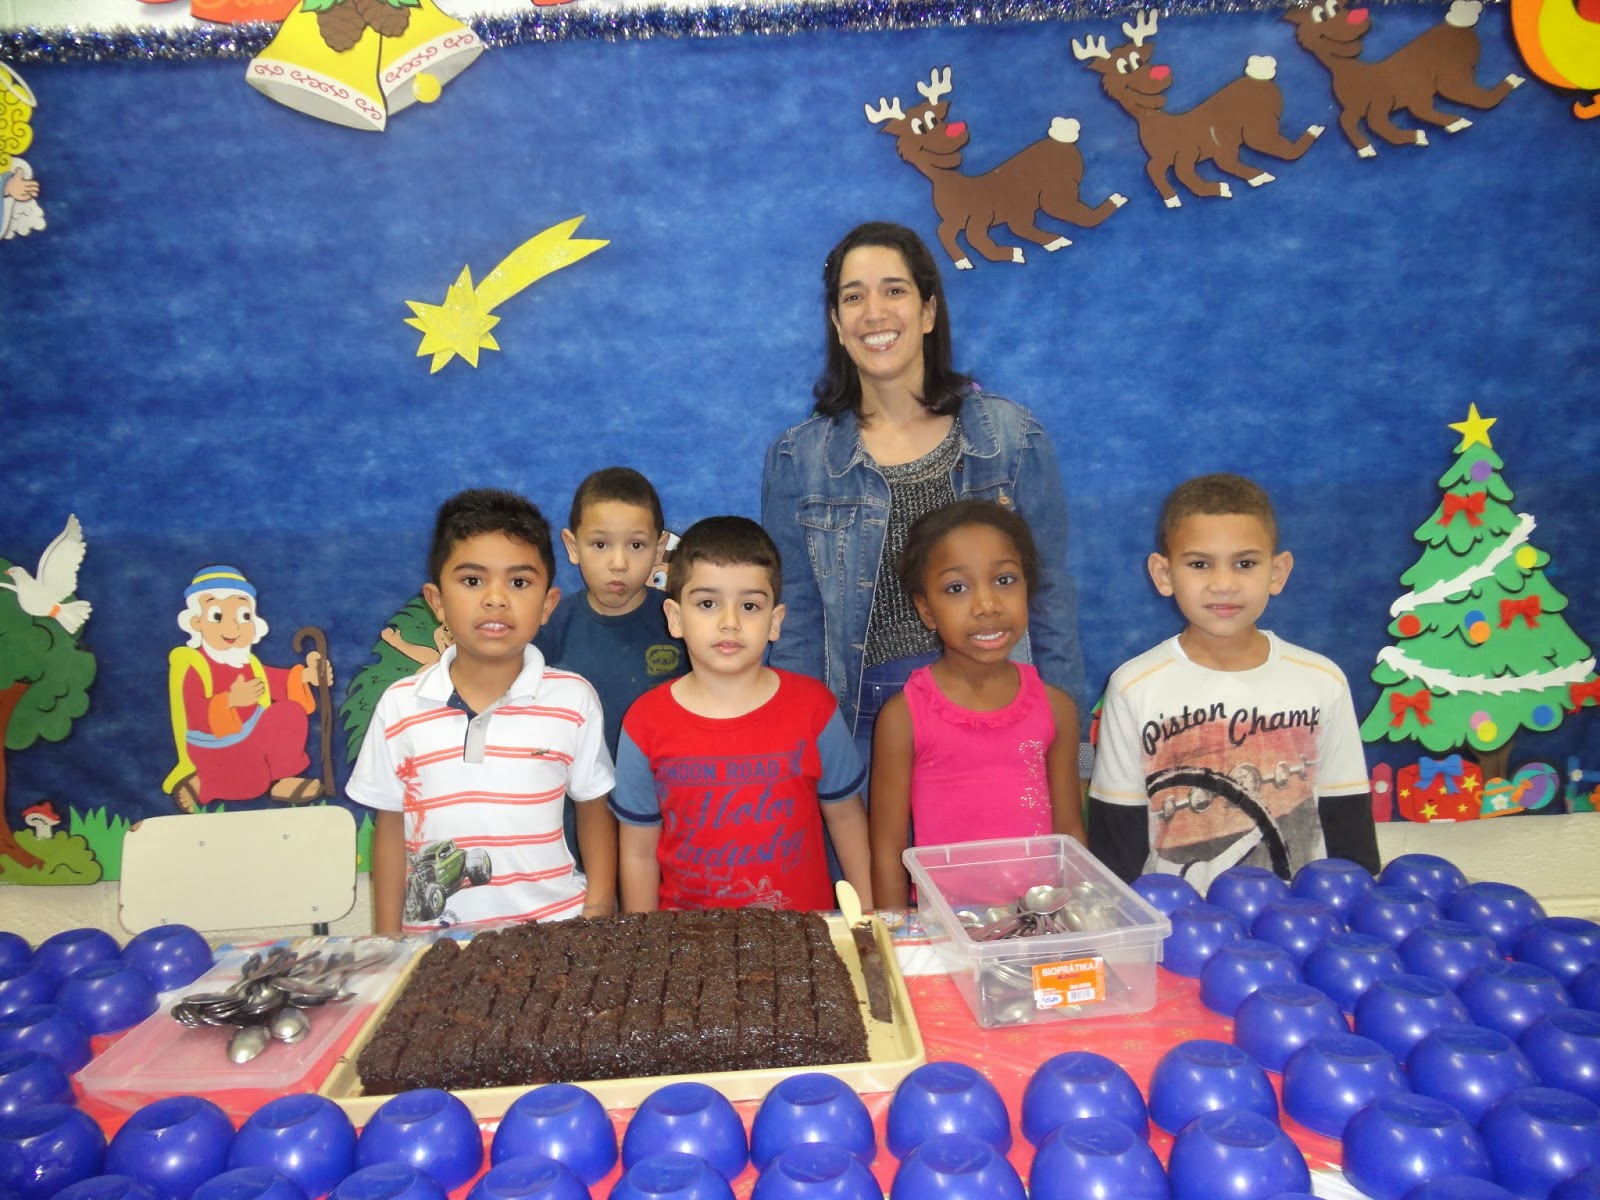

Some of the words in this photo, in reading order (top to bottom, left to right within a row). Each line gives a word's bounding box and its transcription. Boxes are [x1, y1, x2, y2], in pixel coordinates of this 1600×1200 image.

[1142, 702, 1227, 756] Piston
[1228, 706, 1320, 747] Champ
[727, 760, 781, 779] ROAD
[675, 823, 806, 874] Industry
